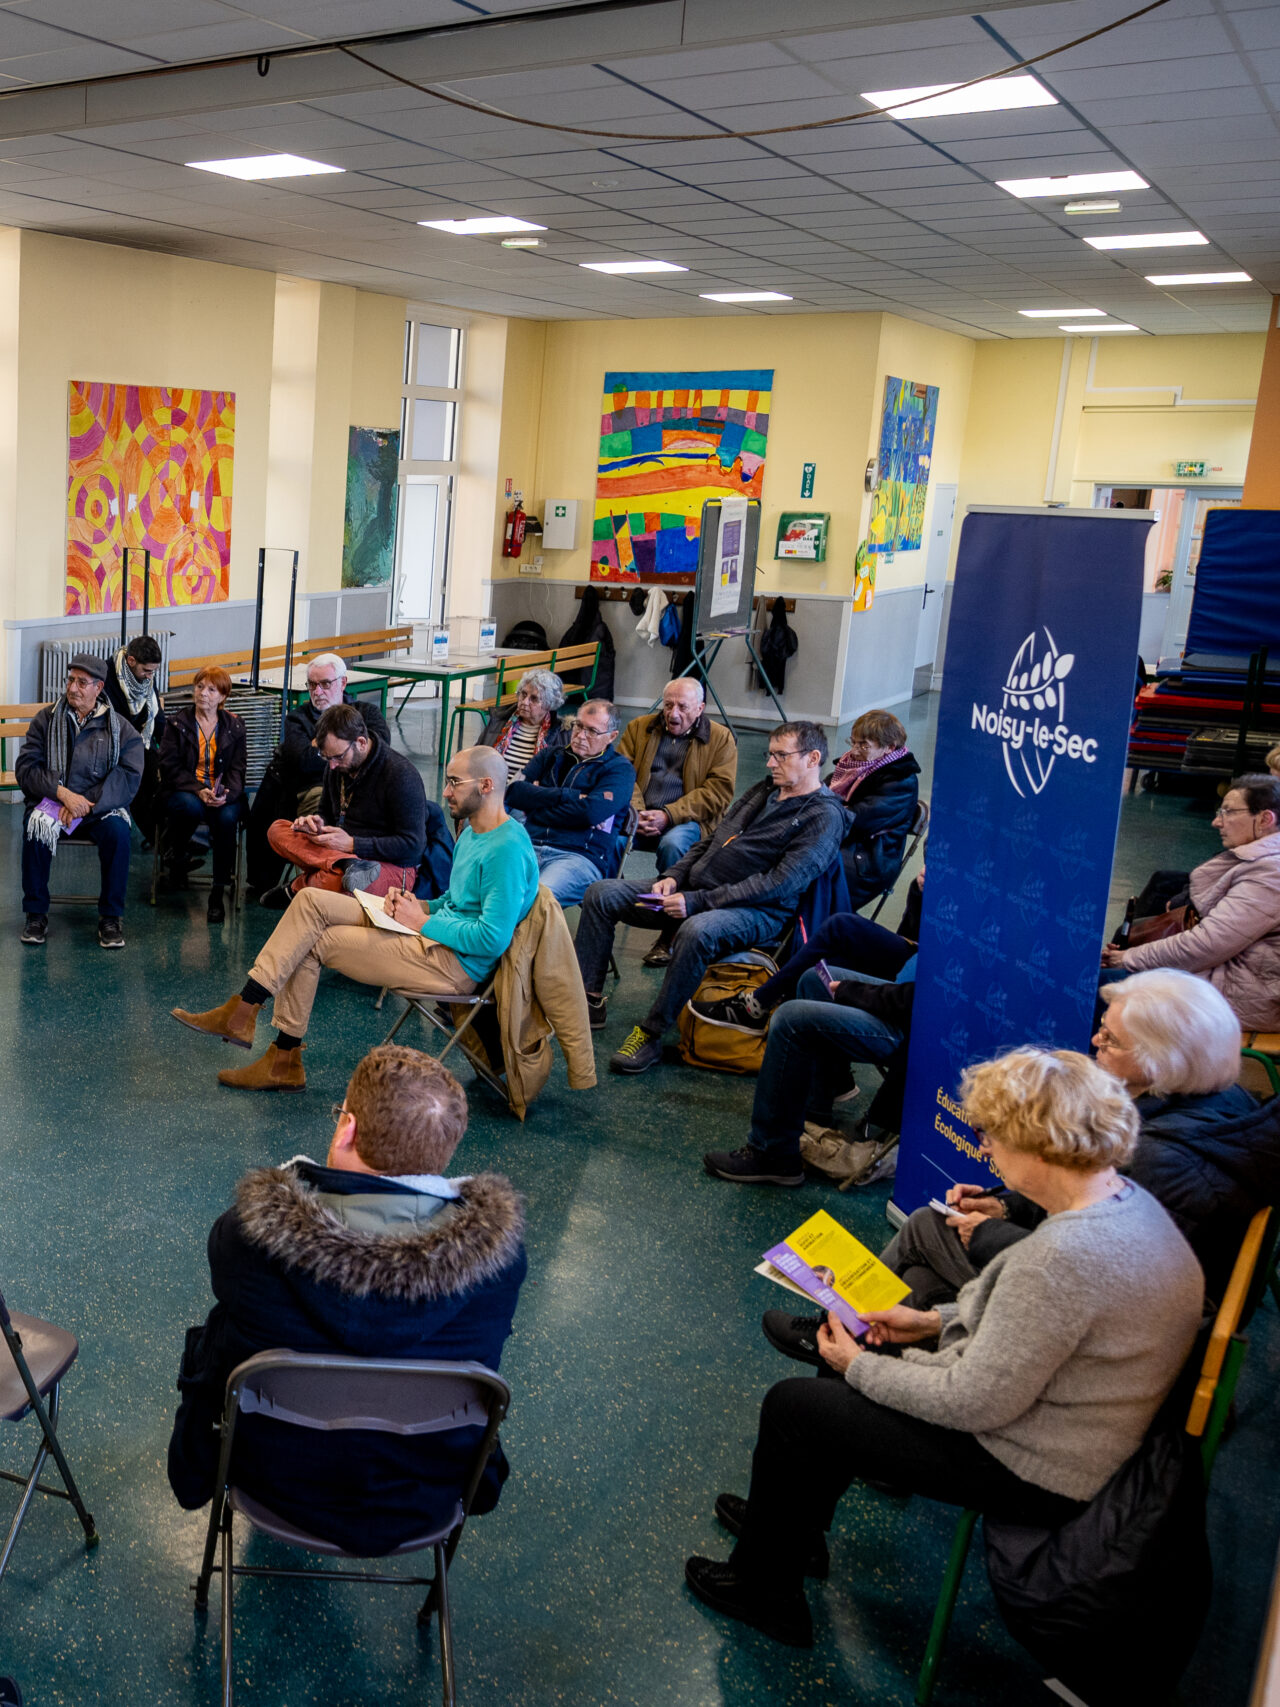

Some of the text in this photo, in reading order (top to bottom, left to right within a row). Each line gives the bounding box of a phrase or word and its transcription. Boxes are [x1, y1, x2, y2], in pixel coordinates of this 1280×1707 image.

[971, 702, 1098, 763] Noisy-le-Sec
[936, 1086, 972, 1127] Éducati
[934, 1113, 982, 1163] Écologique
